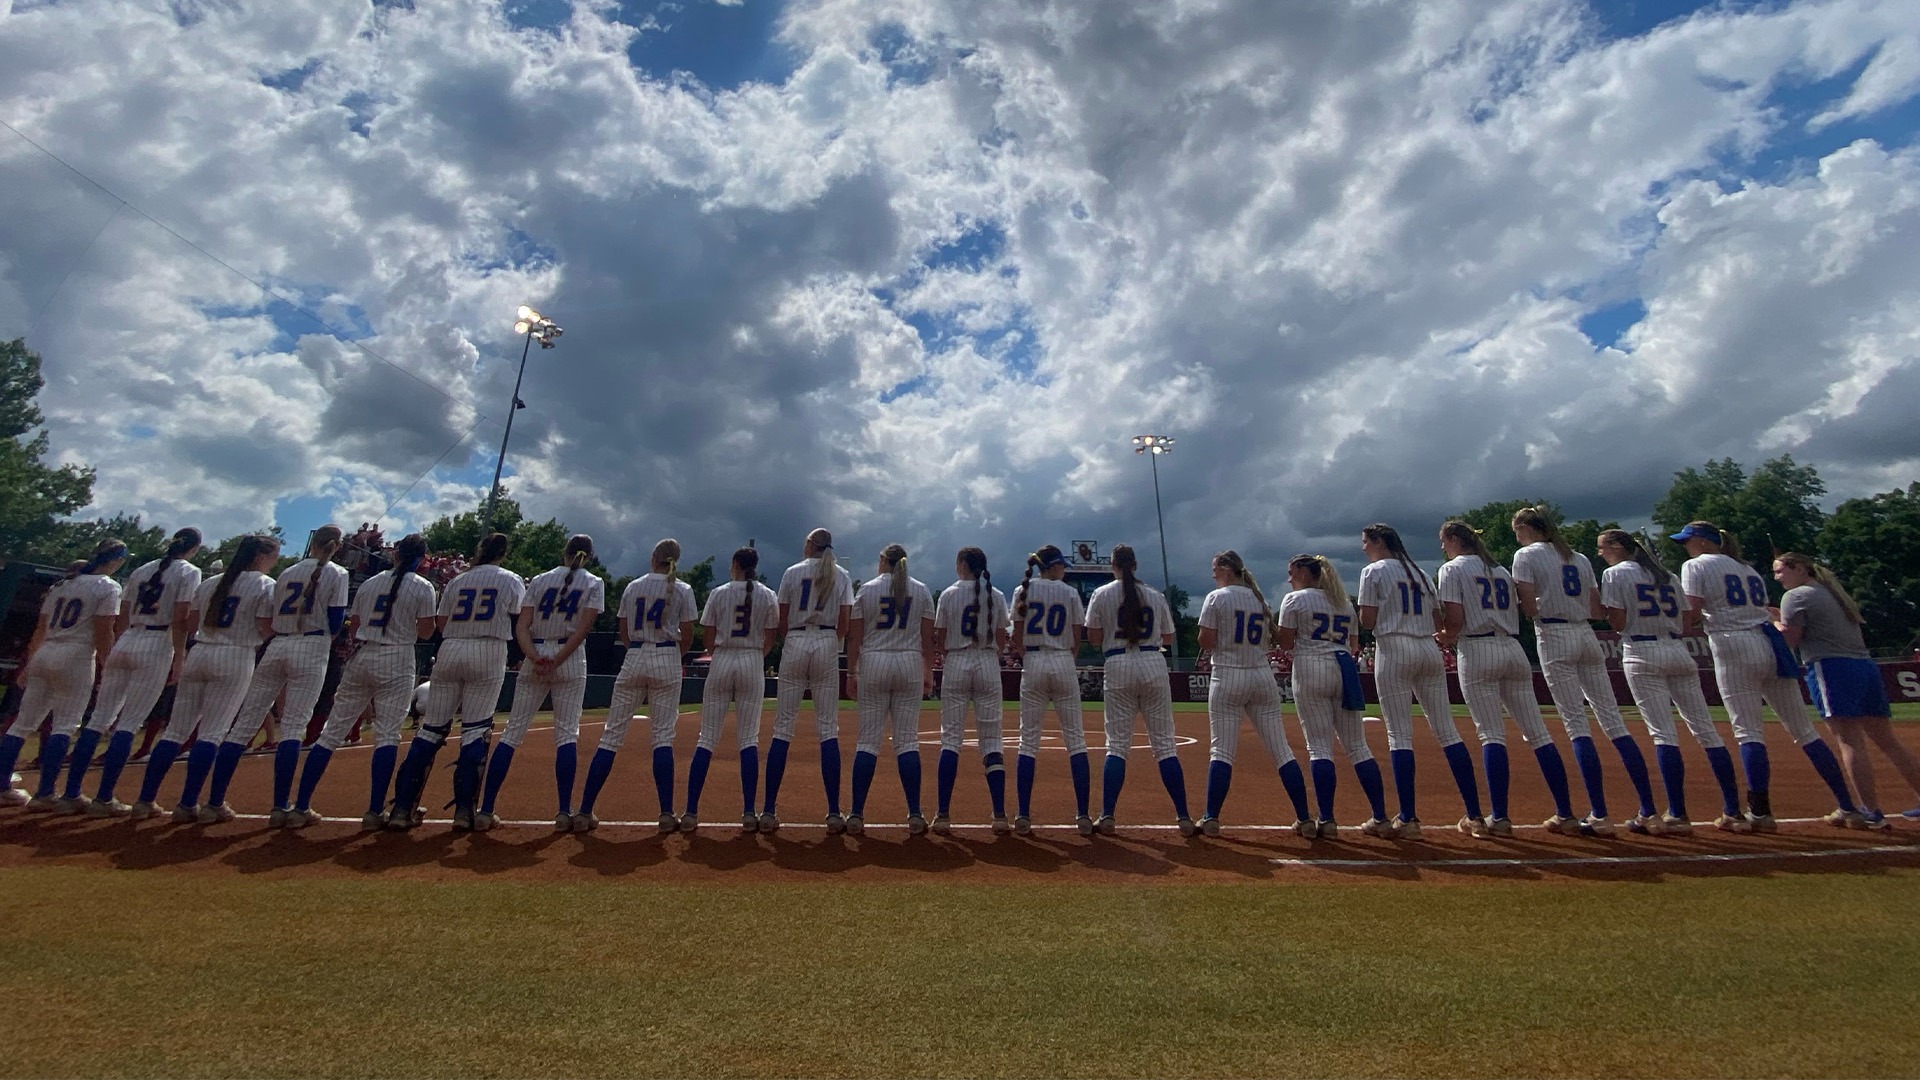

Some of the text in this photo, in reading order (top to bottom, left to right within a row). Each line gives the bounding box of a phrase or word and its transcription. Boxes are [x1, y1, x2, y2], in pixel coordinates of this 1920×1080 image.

[1476, 578, 1509, 609] 28
[1562, 565, 1581, 596] 8
[1724, 575, 1766, 607] 88
[50, 598, 82, 628] 10
[452, 588, 498, 621] 33
[539, 588, 583, 620] 44
[634, 596, 665, 630] 14
[877, 597, 913, 629] 31
[1398, 582, 1422, 615] 11
[1636, 584, 1678, 617] 55
[732, 605, 752, 637] 3
[961, 604, 978, 636] 6
[1027, 602, 1066, 636] 20
[1234, 610, 1264, 645] 16
[1311, 613, 1351, 644] 25
[1188, 674, 1209, 688] 201
[1898, 671, 1920, 697] S
